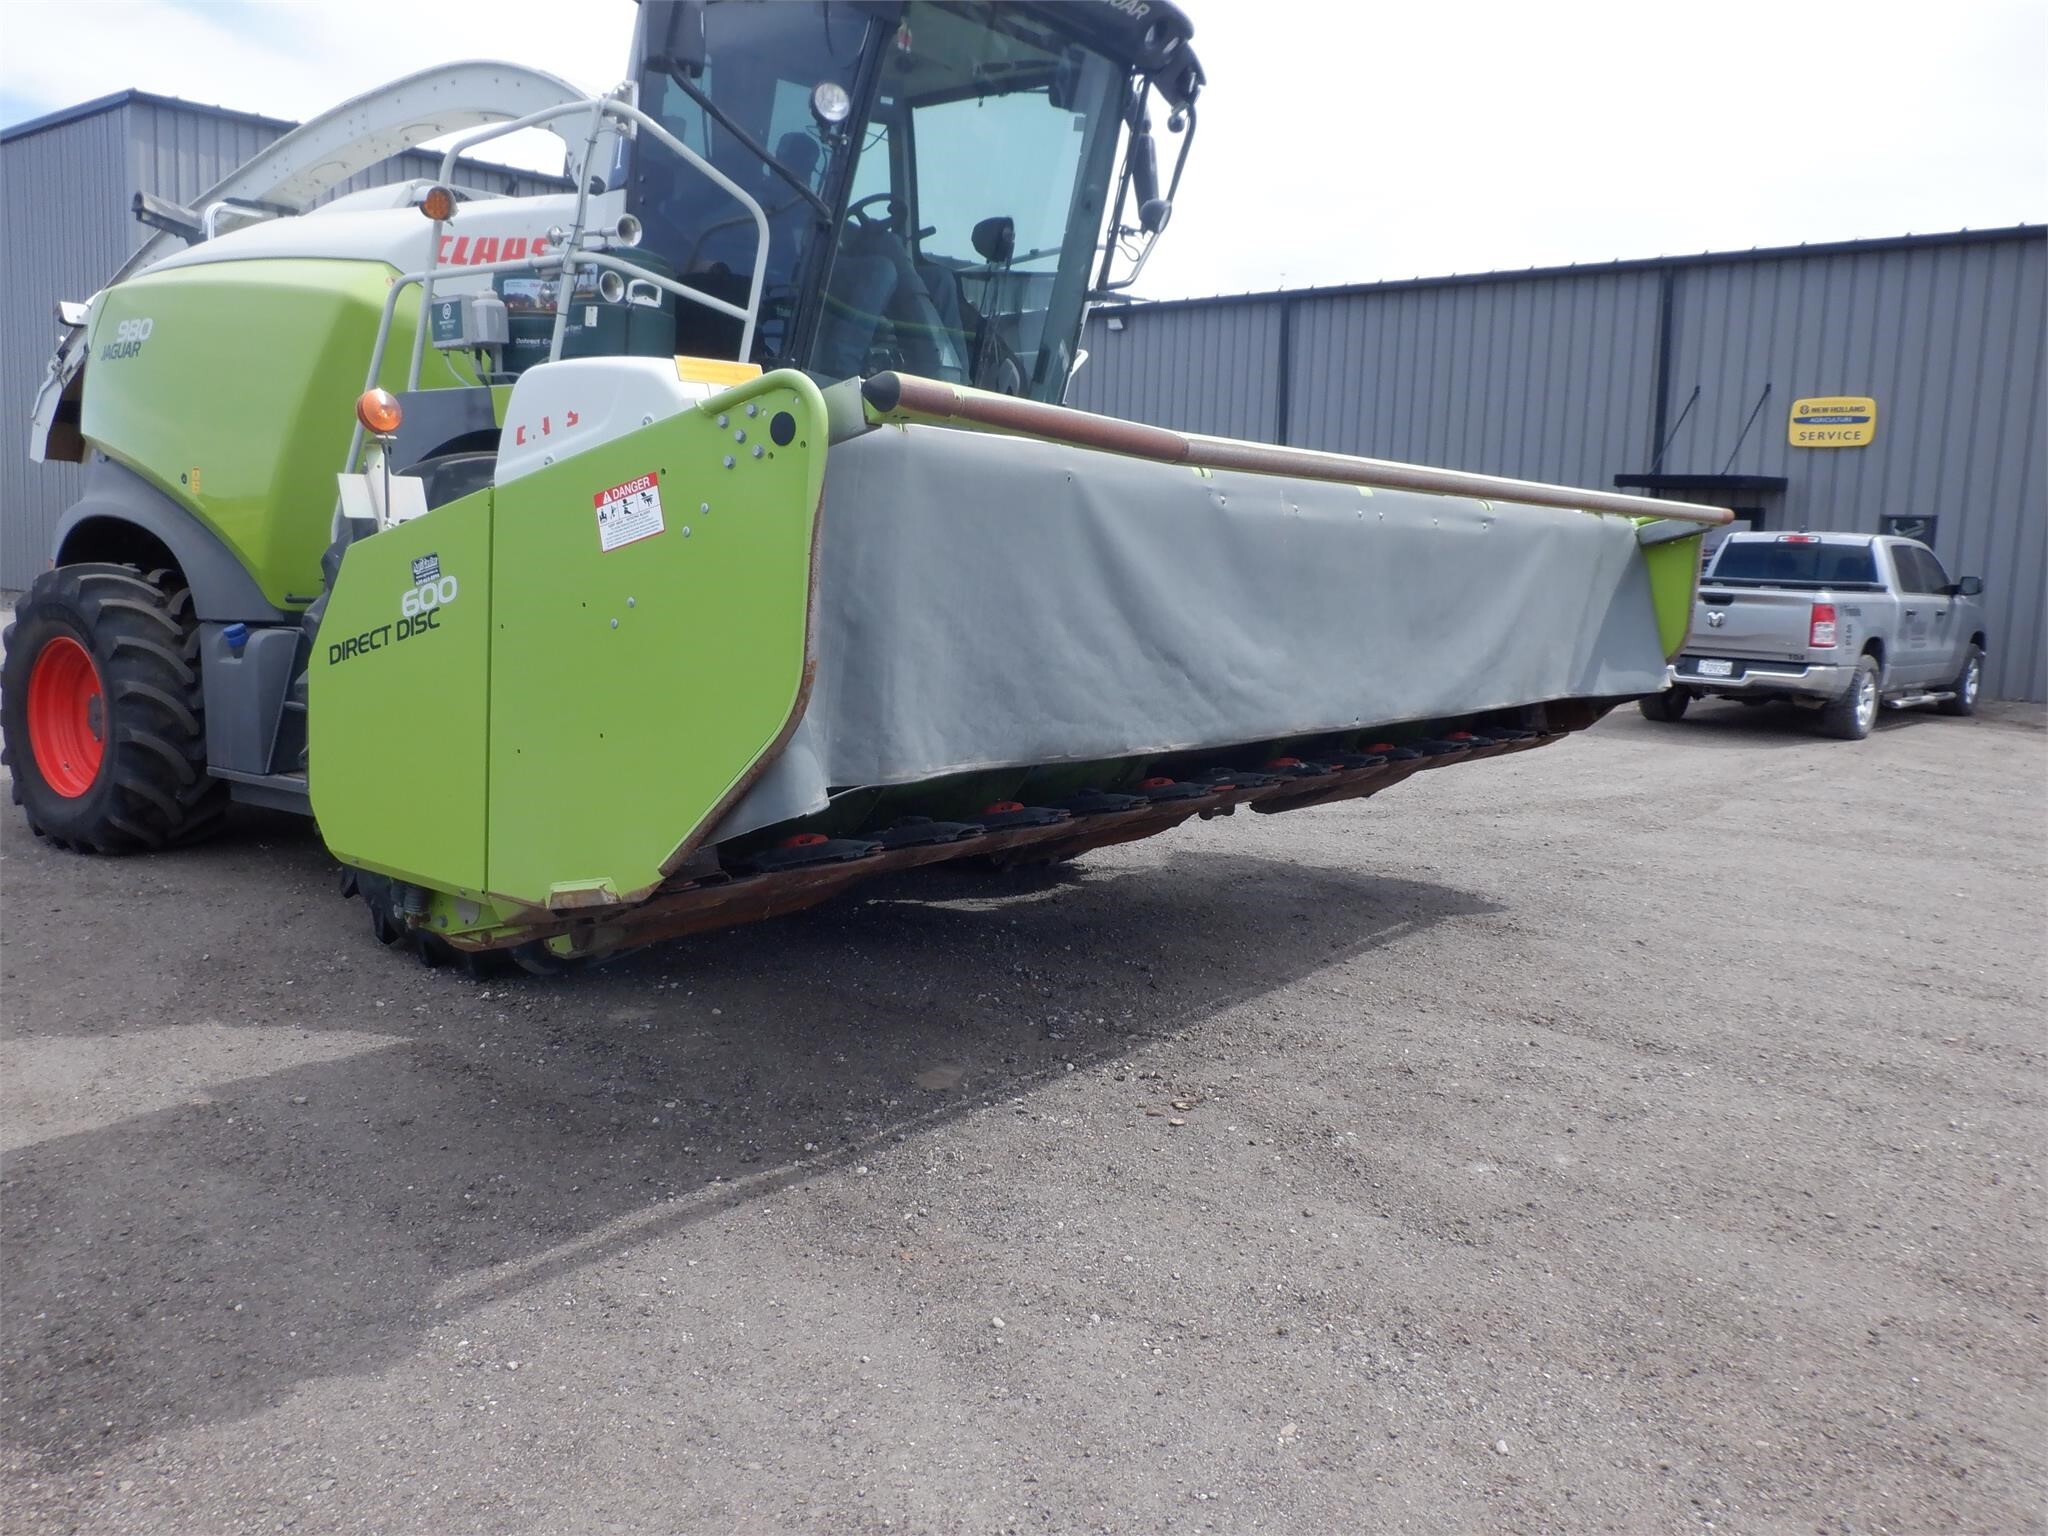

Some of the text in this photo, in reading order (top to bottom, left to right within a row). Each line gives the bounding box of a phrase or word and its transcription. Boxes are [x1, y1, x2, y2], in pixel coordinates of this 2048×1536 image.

[117, 318, 152, 342] 980
[101, 341, 141, 360] JAGUAR
[1831, 405, 1866, 413] HOLLAND
[1799, 430, 1861, 441] SERVICE
[612, 476, 651, 500] DANGER
[402, 575, 457, 617] 600
[329, 606, 440, 666] DIRECT DISC
